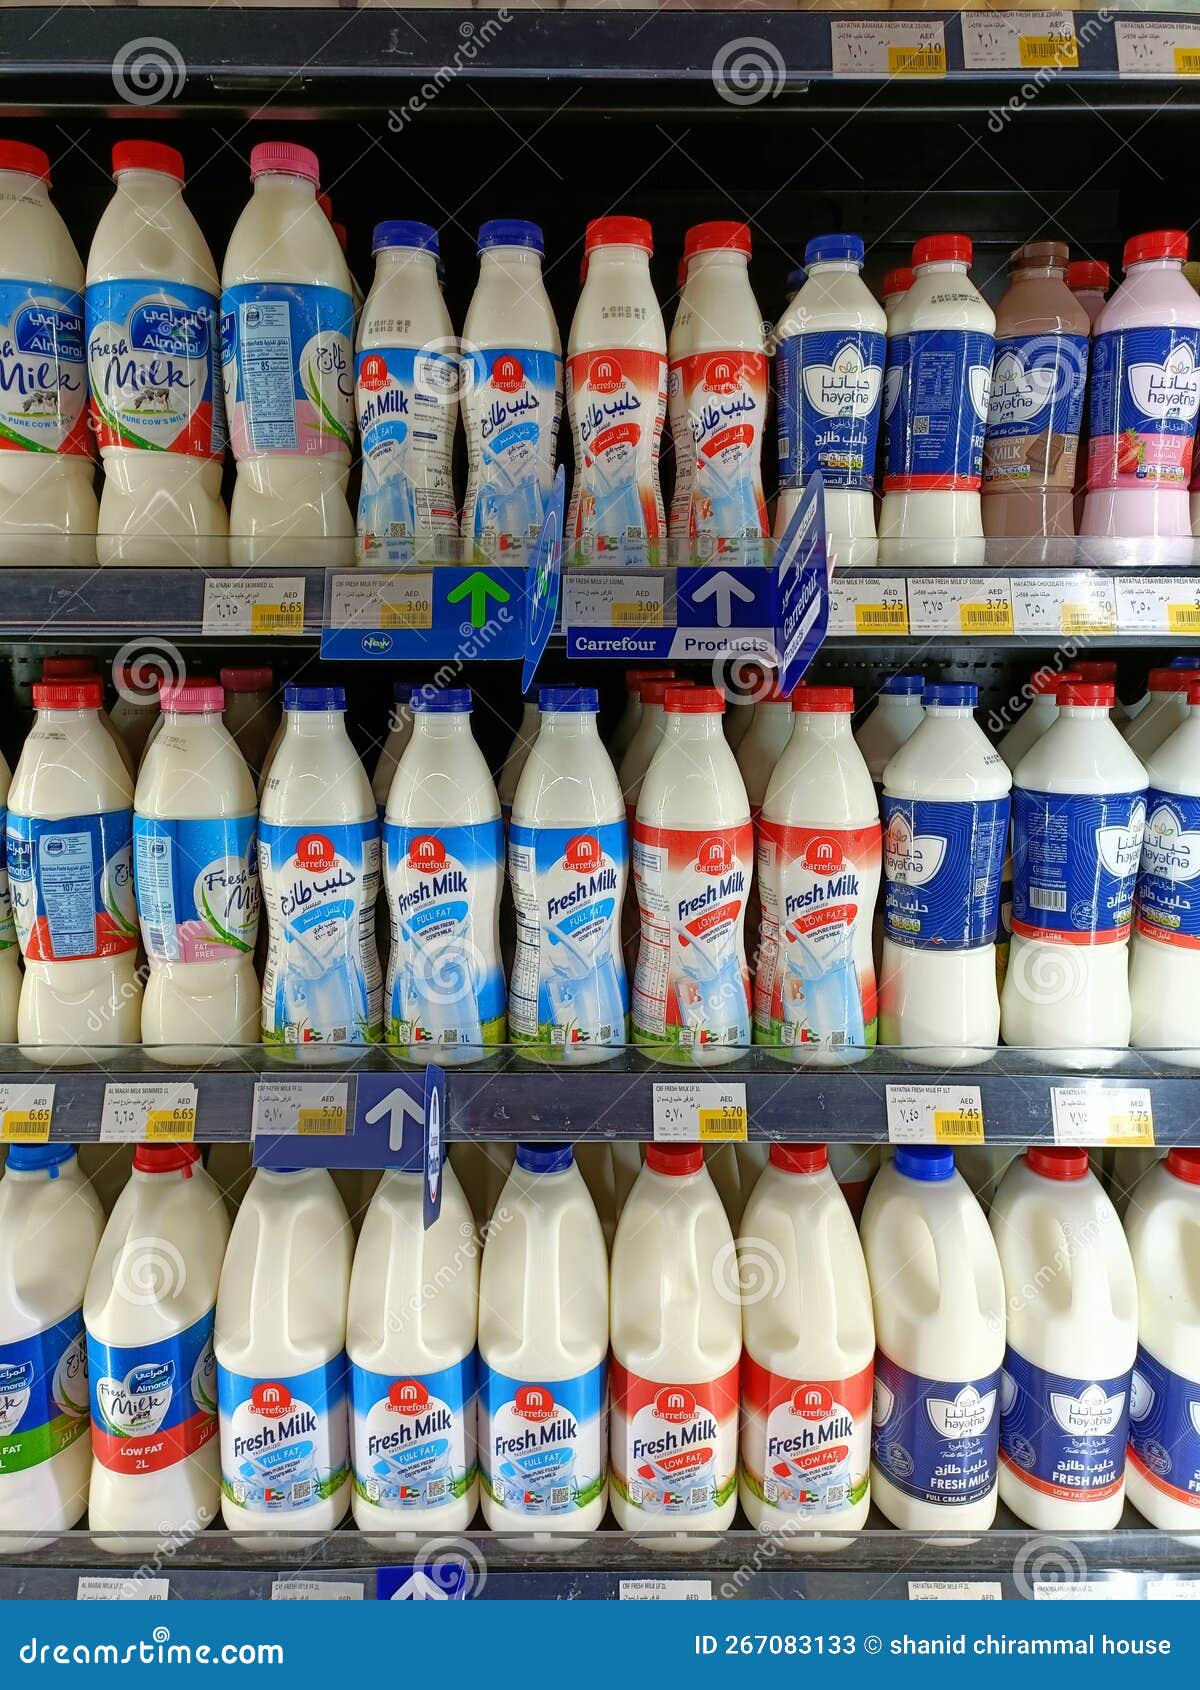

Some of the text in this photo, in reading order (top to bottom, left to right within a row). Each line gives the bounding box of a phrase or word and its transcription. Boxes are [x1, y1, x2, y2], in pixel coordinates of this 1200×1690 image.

[918, 43, 941, 54] 2.10
[29, 311, 81, 331] المراعي
[144, 309, 201, 330] المراعي
[89, 337, 128, 362] Fresh
[260, 361, 270, 371] 85
[104, 356, 196, 395] Milk
[490, 380, 526, 390] Carrefour
[587, 381, 626, 391] Carrefour
[821, 375, 870, 392] حياتنا
[1150, 374, 1196, 393] حياتنا
[377, 391, 409, 415] Milk
[821, 388, 869, 405] hayatna
[1148, 389, 1195, 406] hayatna
[507, 392, 540, 417] حليب
[603, 392, 641, 418] حليب
[721, 393, 756, 418] حليب
[8, 417, 30, 428] PURE
[381, 425, 394, 437] FAT
[815, 432, 868, 446] حليب طازج
[994, 447, 1021, 460] MILK
[280, 602, 301, 612] 6.65
[407, 601, 428, 611] 3.00
[637, 601, 659, 611] 3.00
[784, 568, 817, 642] Carrefour
[881, 599, 903, 610] 3.75
[986, 599, 1008, 609] 3.75
[575, 637, 769, 652] Carrefour Products
[293, 858, 340, 869] Carrefour
[408, 860, 451, 869] Carrefour
[563, 859, 606, 870] Carrefour
[695, 862, 735, 872] Carrefour
[801, 861, 846, 871] Carrefour
[62, 883, 74, 892] 107
[204, 870, 247, 892] Fresh
[280, 868, 356, 916] حليب طازج
[398, 872, 468, 915] Fresh Milk
[547, 868, 617, 920] Fresh Milk
[678, 871, 744, 924] Fresh Milk
[785, 875, 859, 917] Fresh Milk
[898, 901, 929, 913] حليب
[1157, 896, 1190, 910] حليب
[416, 908, 451, 924] FULL FAT
[569, 914, 587, 928] FULL
[698, 914, 715, 930] LOW
[802, 909, 843, 927] LOW FAT
[195, 950, 214, 958] FREE
[461, 1035, 470, 1043] 1L
[613, 1029, 619, 1037] 1L
[848, 1037, 855, 1045] 1L
[29, 1109, 50, 1121] 6.65
[173, 1108, 194, 1119] 6.65
[323, 1106, 342, 1117] 5.70
[723, 1106, 742, 1117] 5.70
[959, 1108, 979, 1119] 7.45
[1129, 1111, 1148, 1121] 7.75
[135, 1365, 168, 1381] المراعي
[100, 1383, 127, 1398] Fresh
[136, 1378, 170, 1393] Almarai
[111, 1396, 165, 1417] Milk
[248, 1403, 296, 1415] Carrefour
[385, 1402, 433, 1412] Carrefour
[511, 1407, 559, 1418] Carrefour
[789, 1407, 837, 1417] Carrefour
[945, 1407, 986, 1418] حياتنا
[1070, 1405, 1113, 1417] حياتنا
[652, 1409, 699, 1419] Carrefour
[944, 1416, 985, 1432] hayatna
[1069, 1415, 1112, 1428] hayatna
[234, 1412, 317, 1457] Fresh Milk
[368, 1409, 452, 1456] Fresh Milk
[495, 1419, 577, 1456] Fresh Milk
[768, 1416, 853, 1457] Fresh Milk
[633, 1420, 717, 1460] Fresh Milk
[3, 1444, 22, 1454] FAT
[120, 1443, 164, 1456] LOW FAT
[399, 1446, 436, 1464] FULL FAT
[262, 1447, 300, 1466] FULL FAT
[523, 1452, 560, 1468] FULL FAT
[664, 1454, 700, 1470] LOW FAT
[800, 1451, 838, 1469] LOW FAT
[136, 1460, 149, 1469] 2L
[284, 1467, 297, 1475] MILK
[408, 1463, 420, 1471] PURE
[420, 1466, 432, 1474] MILK
[935, 1459, 987, 1475] حليب طازج
[1057, 1459, 1114, 1472] حليب طازج
[543, 1472, 556, 1481] MILK
[820, 1471, 833, 1479] MILK
[930, 1471, 990, 1490] FRESH MILK
[1052, 1470, 1116, 1485] FRESH MILK
[942, 1495, 966, 1503] CREAM
[1053, 1489, 1070, 1497] LOW
